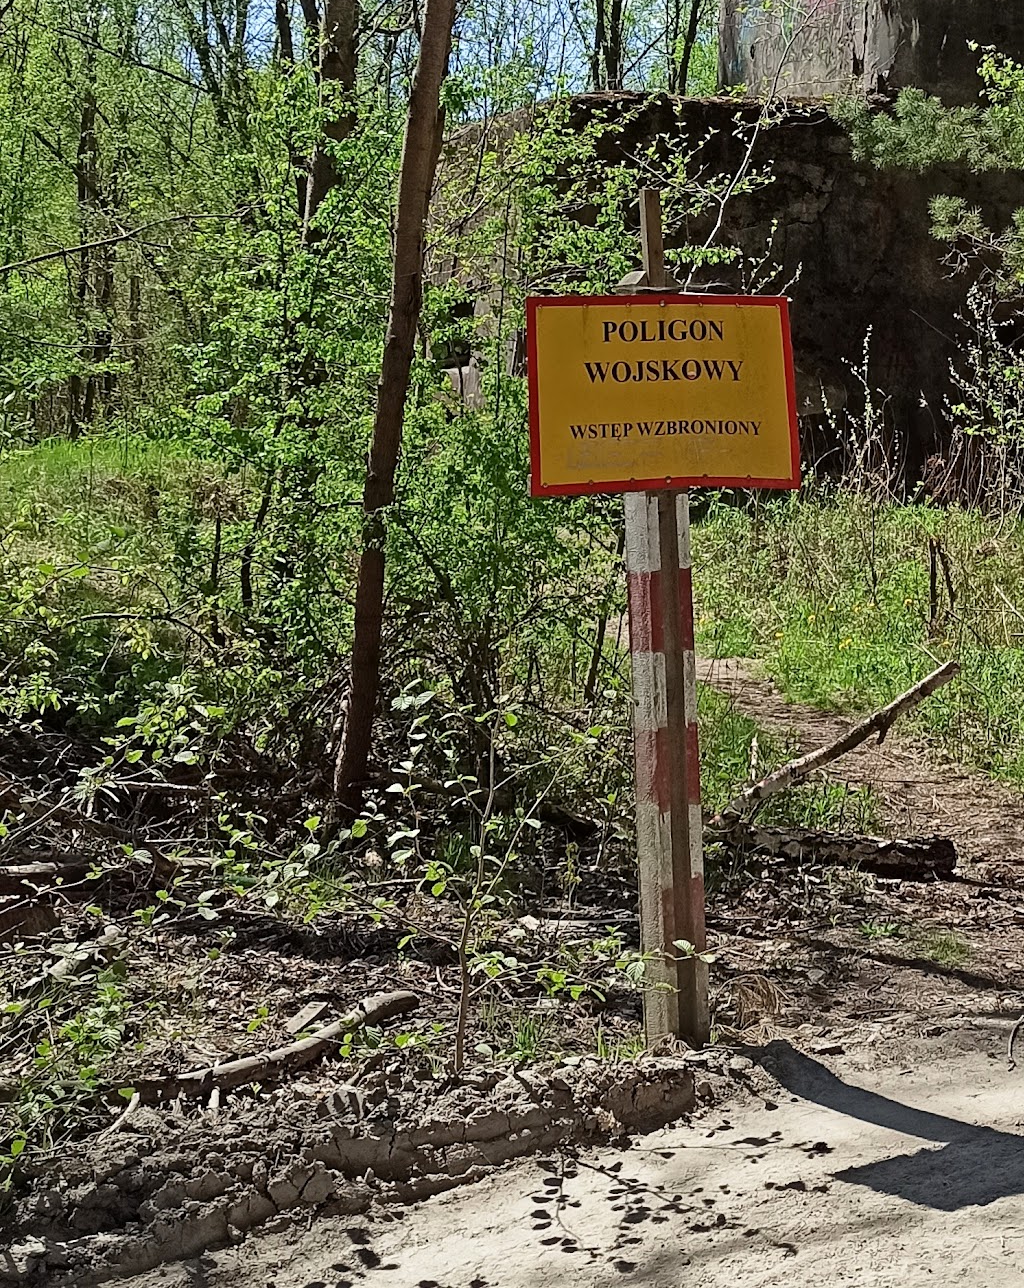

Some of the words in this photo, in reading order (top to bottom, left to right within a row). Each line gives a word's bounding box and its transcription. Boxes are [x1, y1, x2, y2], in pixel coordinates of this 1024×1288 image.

[602, 319, 723, 342] POLIGON
[584, 359, 743, 383] WOJSKOWY
[570, 423, 633, 441] WSTĘP
[637, 419, 761, 436] WZBRONIONY
